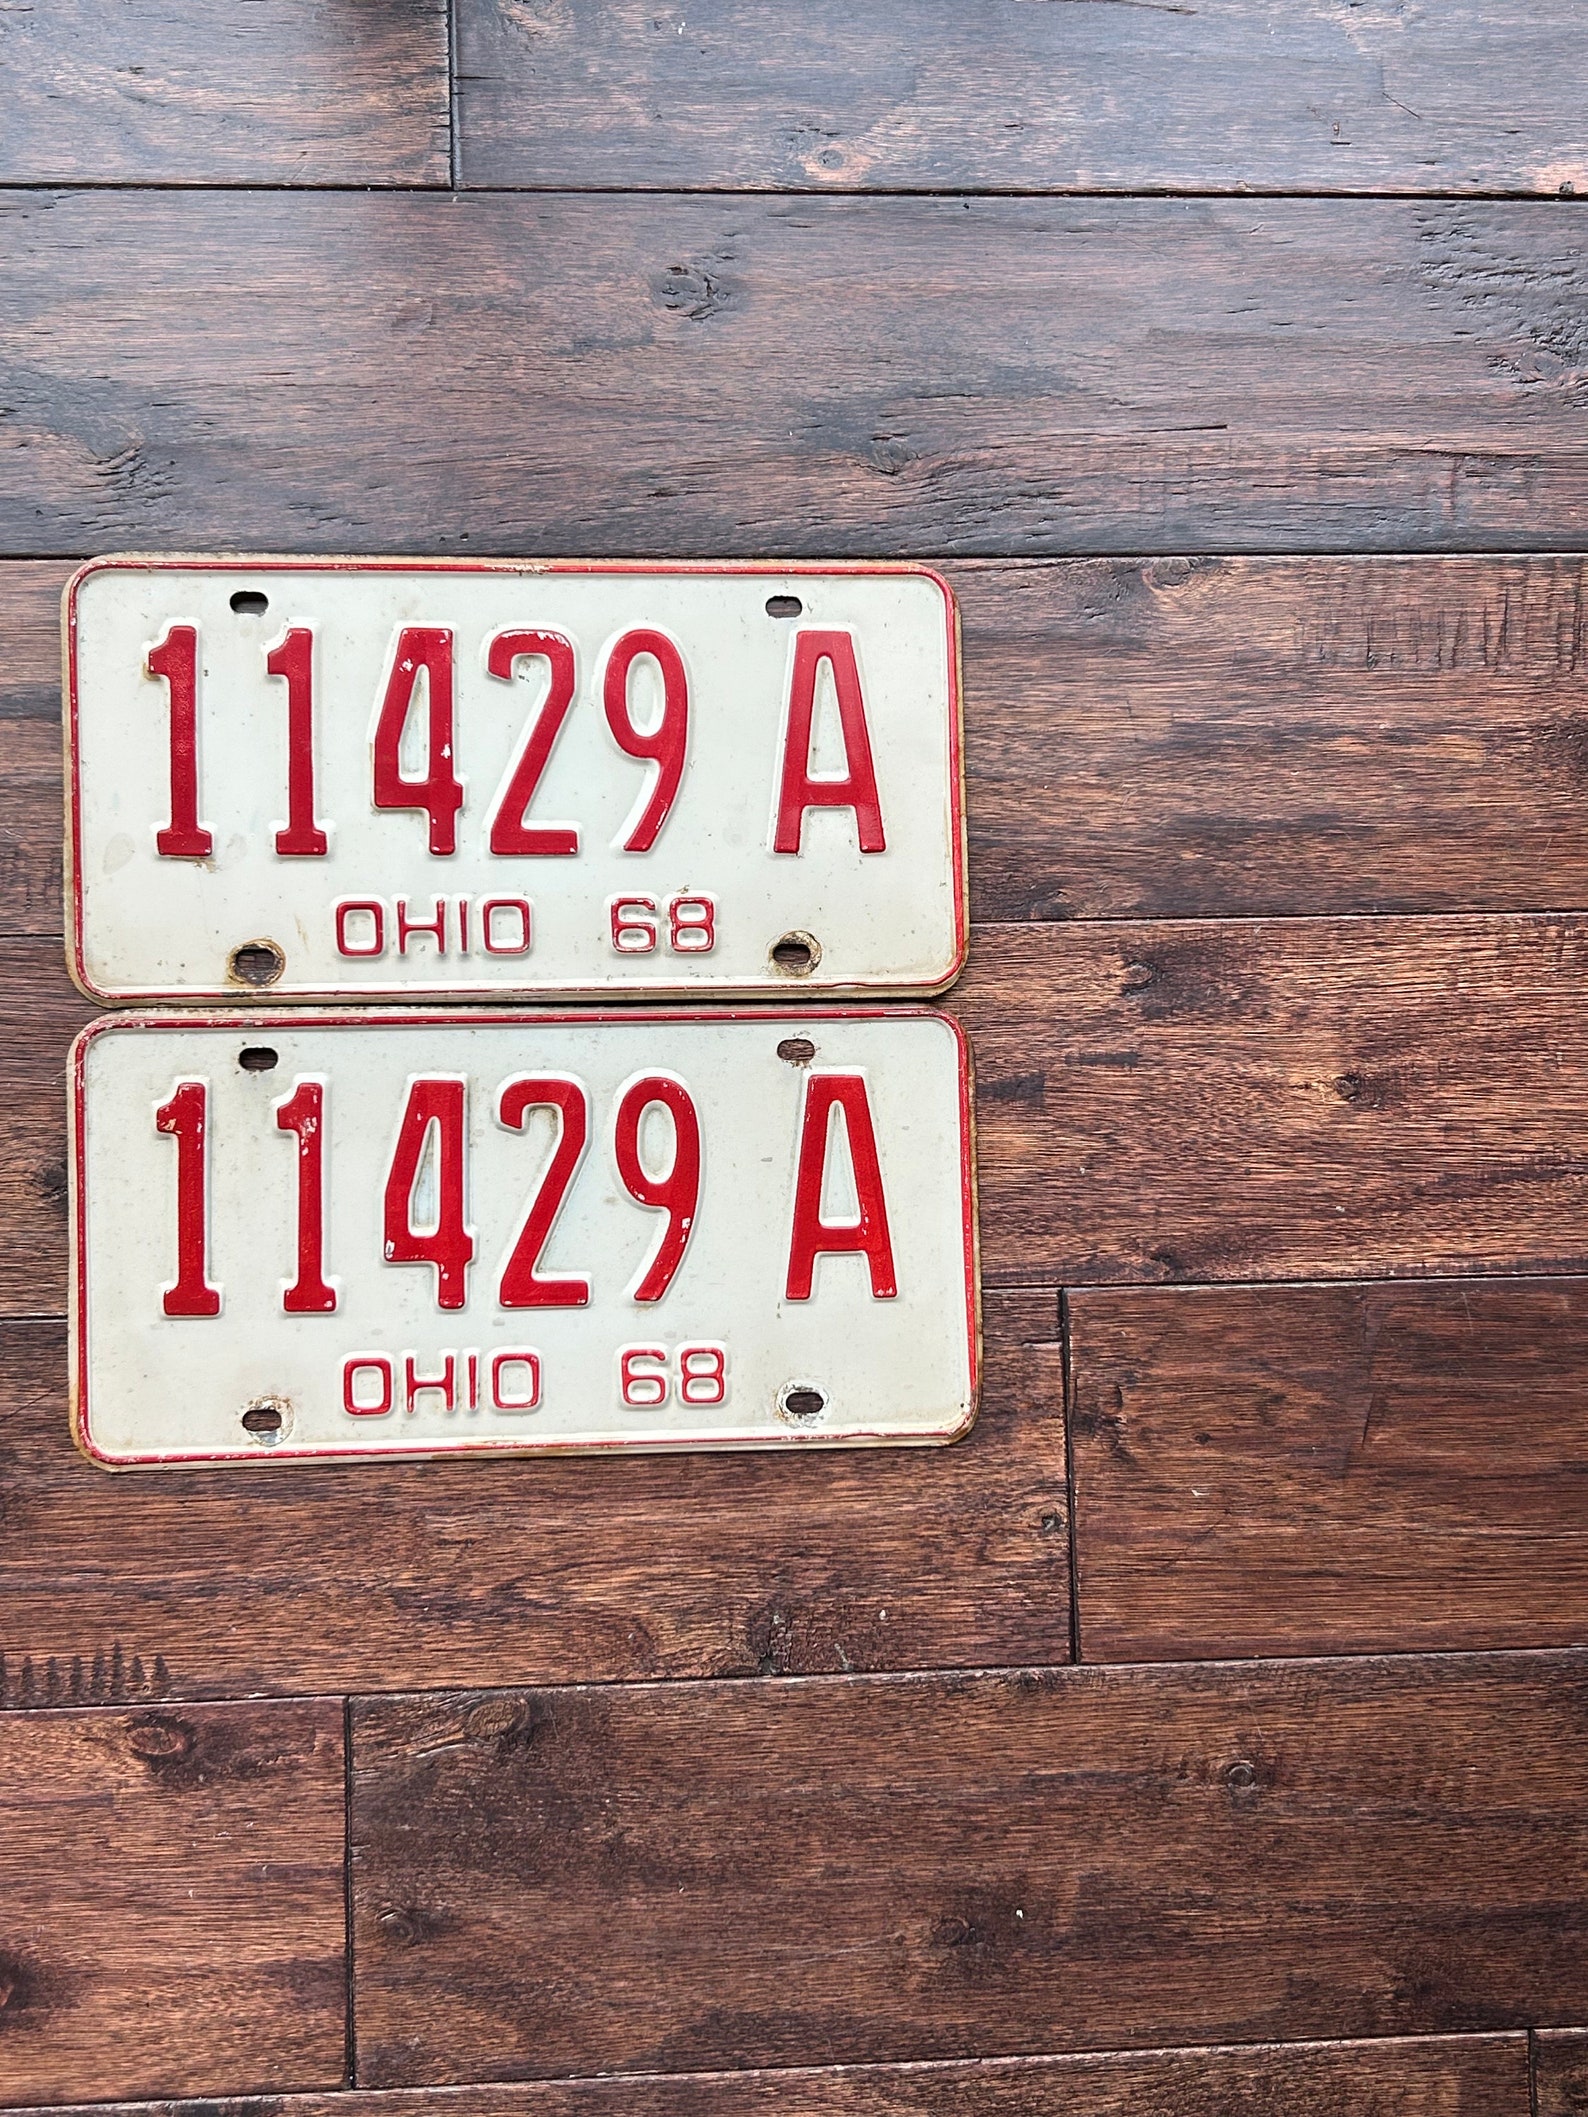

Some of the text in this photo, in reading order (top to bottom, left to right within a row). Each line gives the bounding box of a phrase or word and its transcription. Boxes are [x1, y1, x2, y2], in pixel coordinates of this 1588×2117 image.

[147, 626, 887, 857] 11429 A
[336, 897, 715, 957] OHIO 68
[156, 1074, 898, 1316] 11429 A
[343, 1348, 725, 1415] OHIO 68
